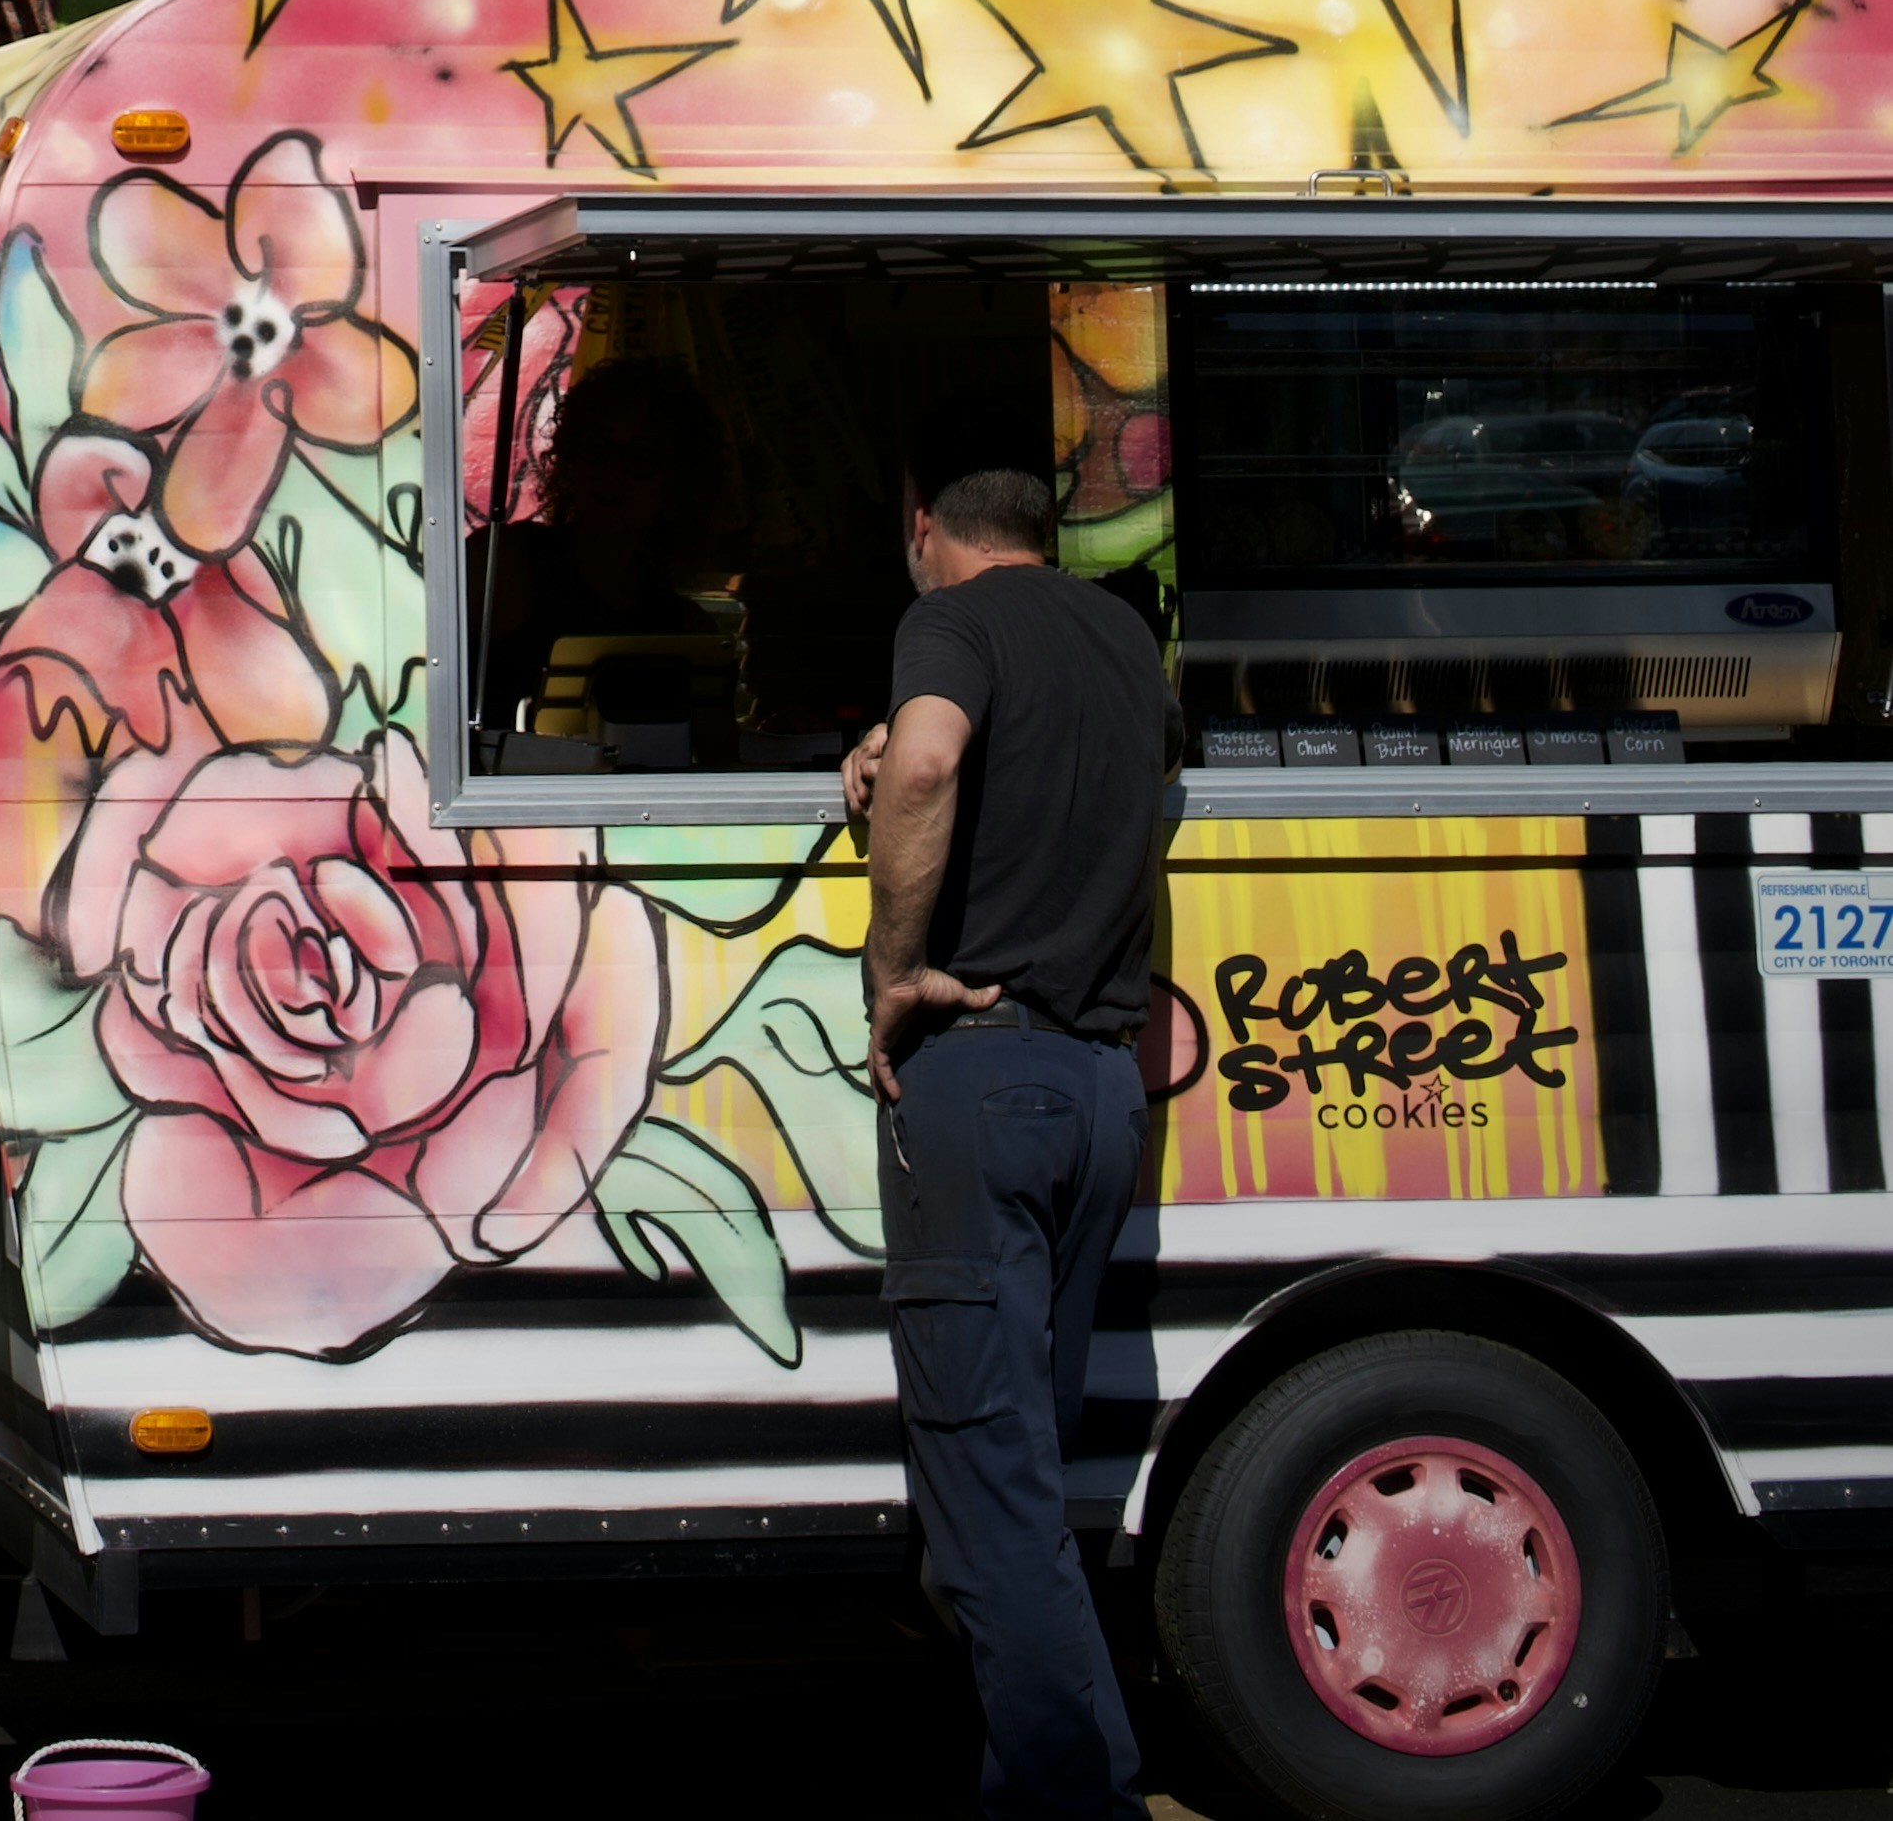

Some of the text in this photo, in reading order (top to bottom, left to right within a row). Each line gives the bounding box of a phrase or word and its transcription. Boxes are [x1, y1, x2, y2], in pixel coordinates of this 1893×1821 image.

[1372, 721, 1418, 740] Peanut
[1454, 719, 1504, 738] Lemon
[1613, 717, 1672, 735] Sweet
[1212, 732, 1265, 745] Toffee
[1624, 736, 1665, 753] Corn
[1297, 740, 1338, 756] Chunk
[1374, 743, 1429, 760] Butter
[1449, 737, 1521, 758] Meringue
[1761, 884, 1867, 896] REFRESHMENT VEHICLE
[1774, 904, 1893, 950] 2127
[1774, 956, 1804, 968] CITY
[1809, 956, 1826, 967] OF
[1318, 1094, 1489, 1129] cookies
